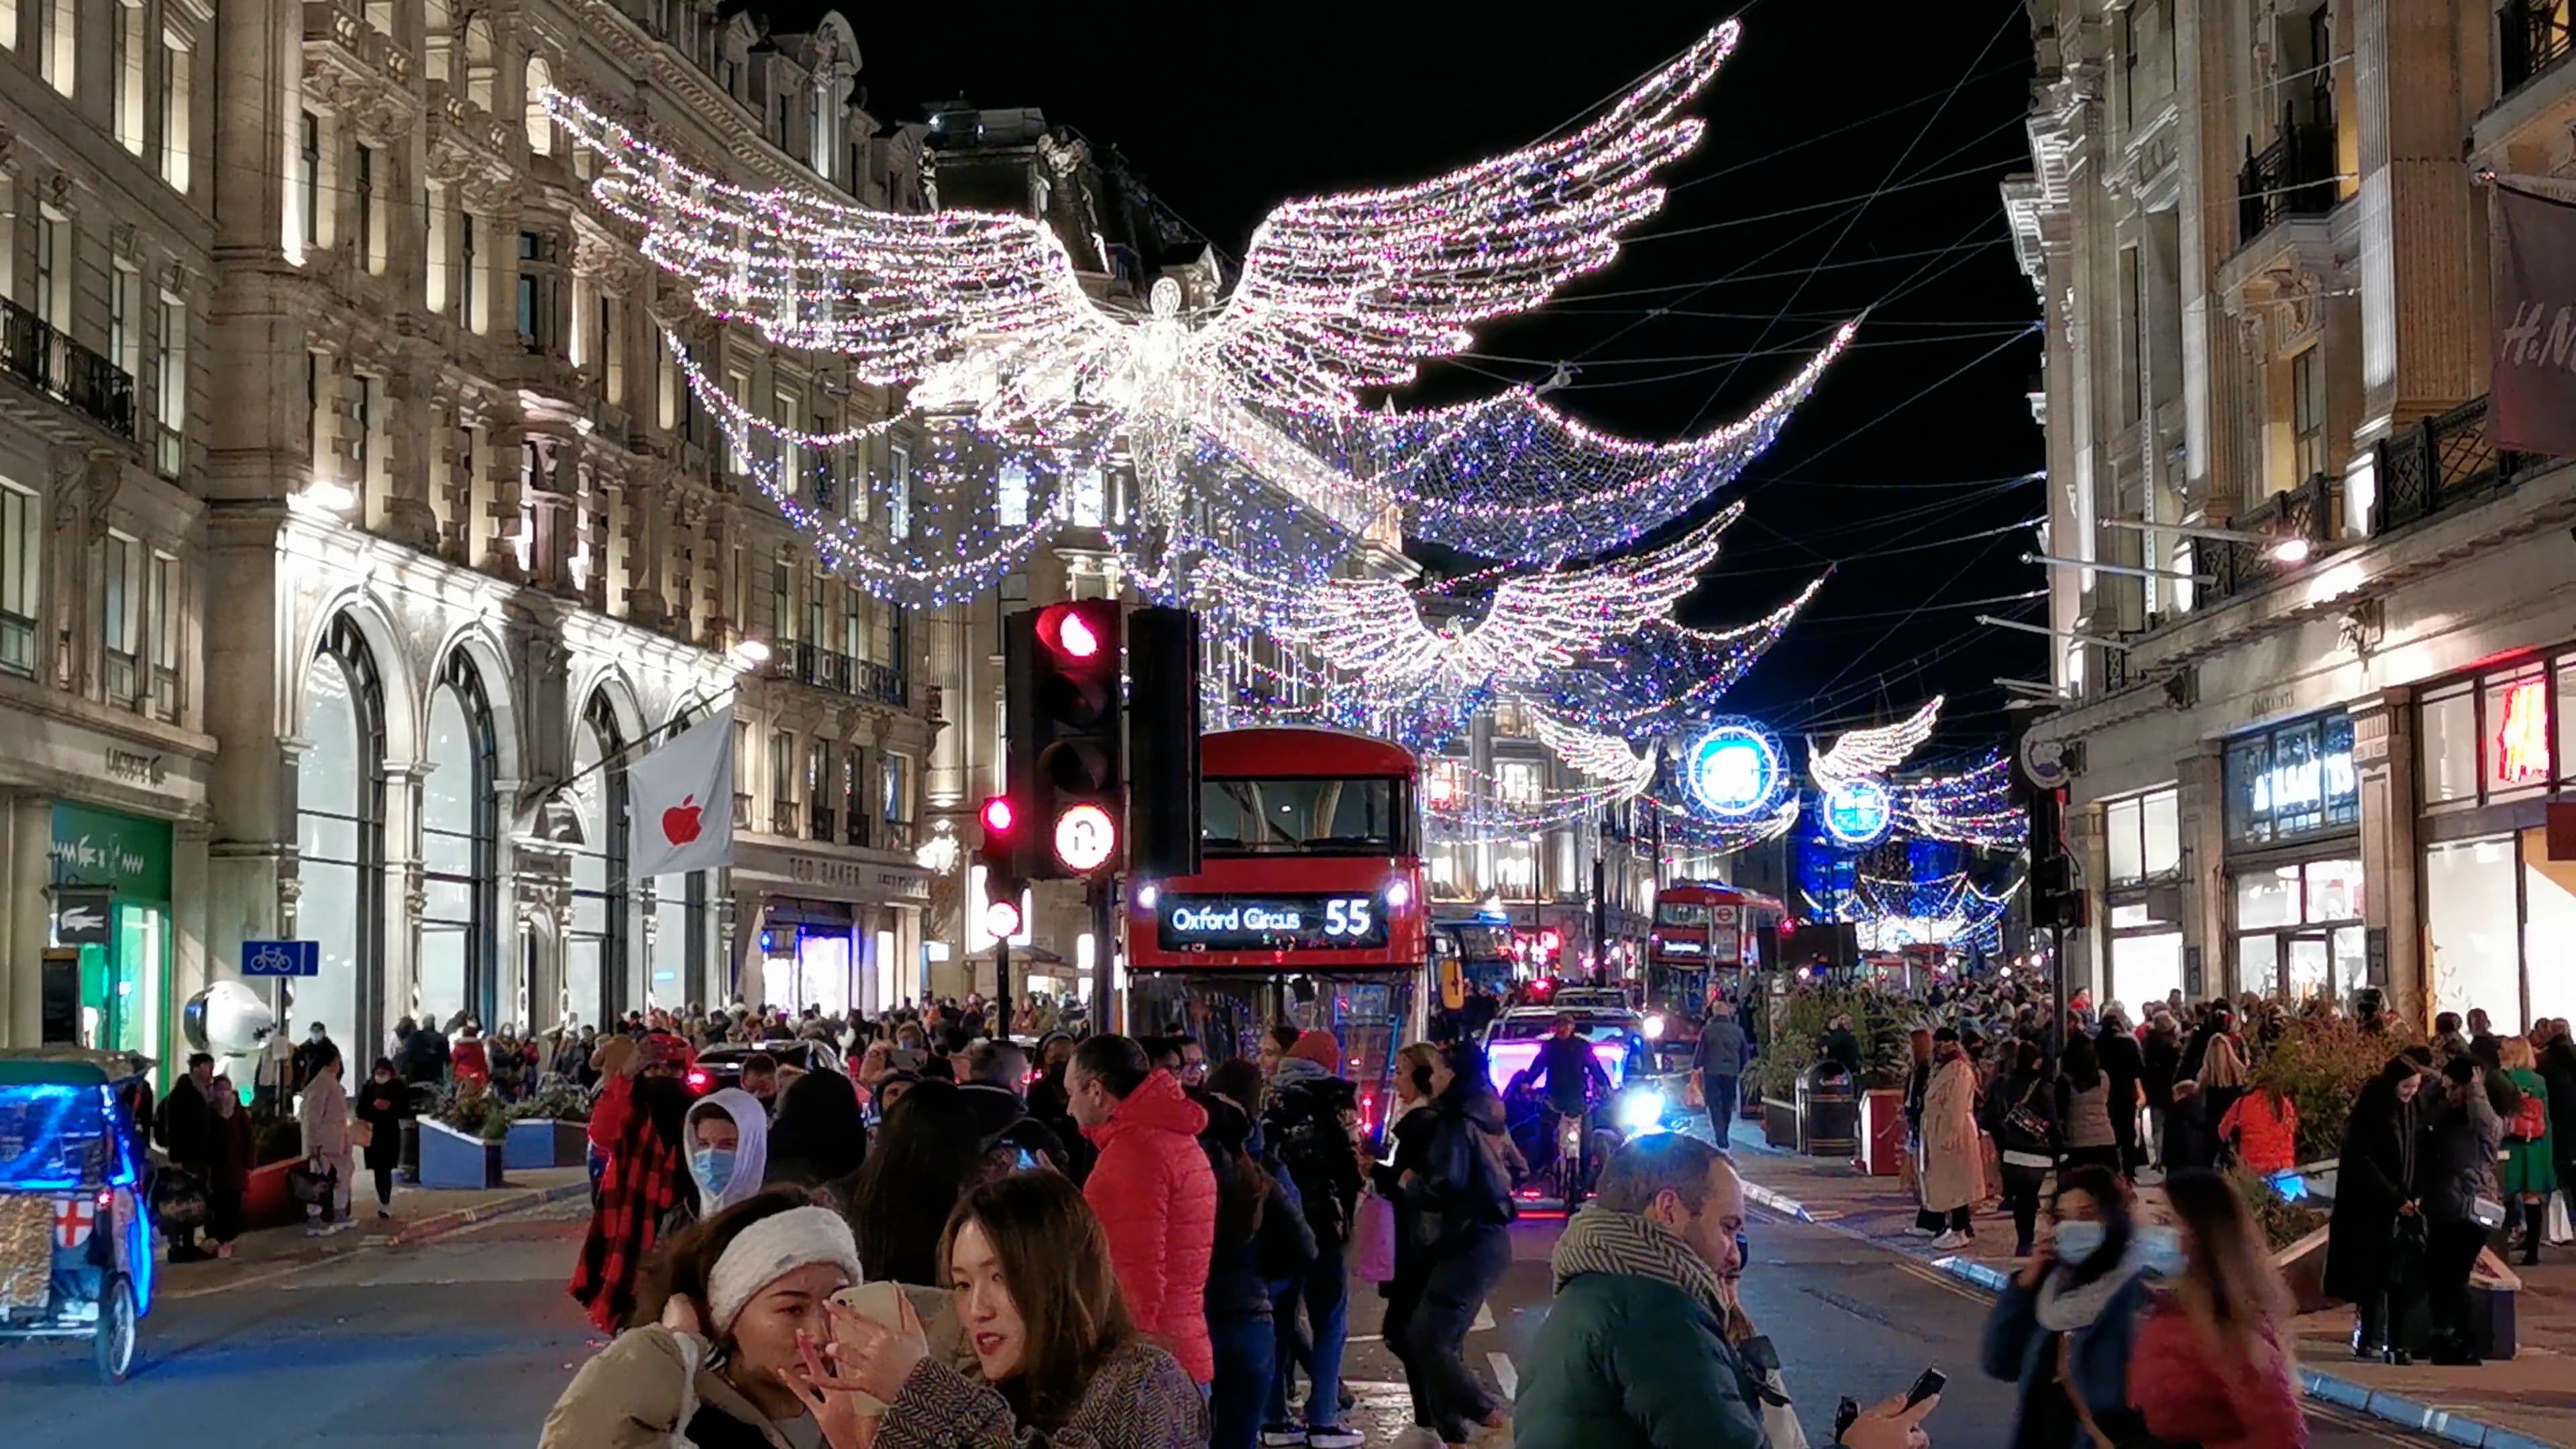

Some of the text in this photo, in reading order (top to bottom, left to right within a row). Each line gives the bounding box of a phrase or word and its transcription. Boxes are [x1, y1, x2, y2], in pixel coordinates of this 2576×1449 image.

[790, 857, 814, 883] TED
[1173, 899, 1371, 936] Oxford Circus 55
